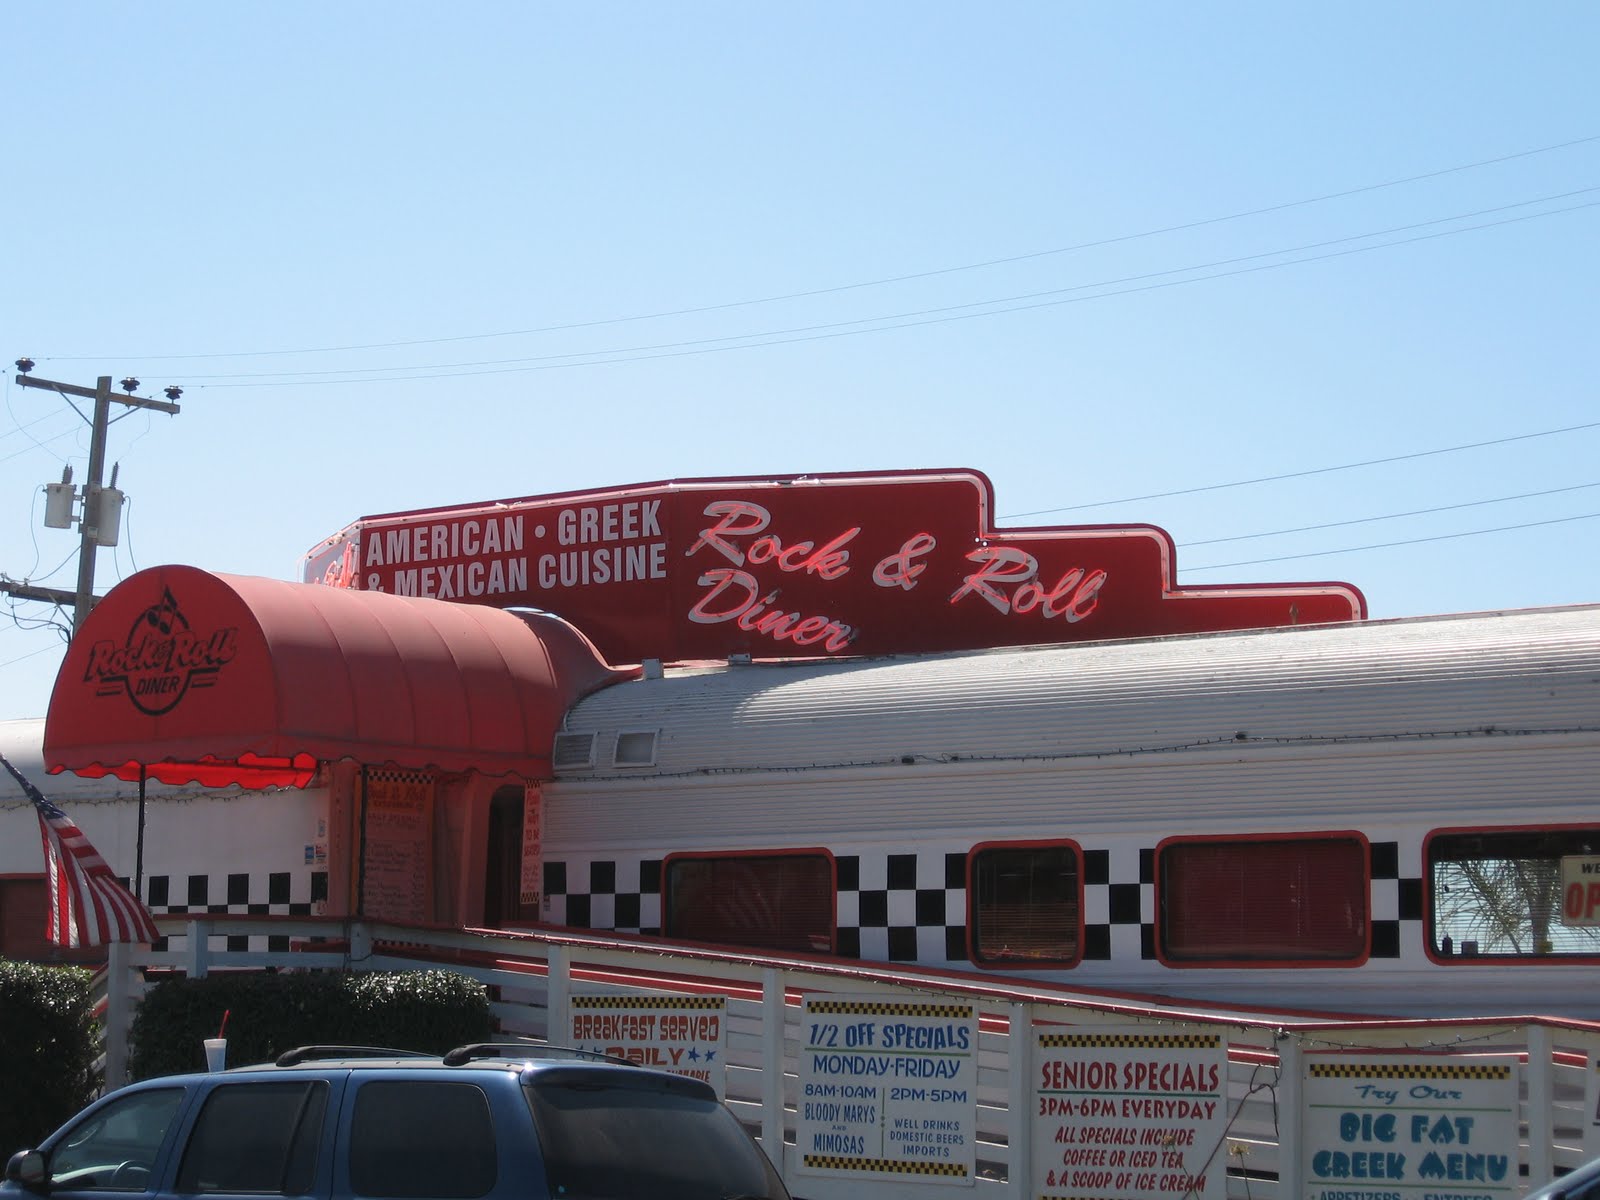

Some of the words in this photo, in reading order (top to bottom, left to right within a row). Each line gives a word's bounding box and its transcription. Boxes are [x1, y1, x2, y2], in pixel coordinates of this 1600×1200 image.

[366, 515, 524, 567] AMERICAN
[557, 499, 662, 546] GREEK
[394, 557, 528, 599] MEXICAN
[538, 542, 667, 590] CUISINE
[685, 500, 862, 581] Rock
[872, 532, 937, 591] &
[948, 546, 1108, 624] Roll
[688, 568, 860, 653] Diner
[135, 676, 181, 696] DINER
[810, 1023, 839, 1048] 1/2
[845, 1022, 875, 1048] OFF
[882, 1023, 970, 1050] SPECIALS
[813, 1054, 960, 1079] MONDAY-FRIDAY
[1042, 1061, 1118, 1090] SENIOR
[1123, 1062, 1219, 1092] SPECIALS
[804, 1083, 877, 1099] 8AM-10AM
[890, 1087, 967, 1103] 2PM-5PM
[1354, 1084, 1399, 1105] Try
[1409, 1085, 1463, 1100] Our
[804, 1102, 841, 1122] BLOODY
[843, 1105, 876, 1124] MARYS
[1039, 1097, 1117, 1117] 3PM-6PM
[1122, 1099, 1217, 1120] EVERYDAY
[894, 1118, 919, 1130] WELL
[923, 1119, 960, 1131] DRINKS
[1340, 1112, 1397, 1143] BIG
[1411, 1114, 1475, 1145] FAT
[813, 1133, 865, 1155] MIMOSAS
[890, 1130, 934, 1144] DOMESTIC
[936, 1135, 965, 1146] BEERS
[1055, 1126, 1076, 1144] ALL
[1078, 1126, 1137, 1146] SPECIALS
[903, 1144, 950, 1158] IMPORTS
[1063, 1148, 1106, 1167] COFFEE
[1109, 1149, 1126, 1167] OR
[1128, 1151, 1158, 1168] ICED
[1161, 1151, 1184, 1169] TEA
[1312, 1150, 1407, 1181] GREEK
[1418, 1151, 1508, 1182] MENU
[1046, 1169, 1057, 1187] &
[1059, 1171, 1069, 1187] A
[1071, 1170, 1113, 1189] SCOOP
[1115, 1172, 1133, 1190] OF
[1134, 1174, 1158, 1190] ICE
[1159, 1174, 1207, 1193] CREAM
